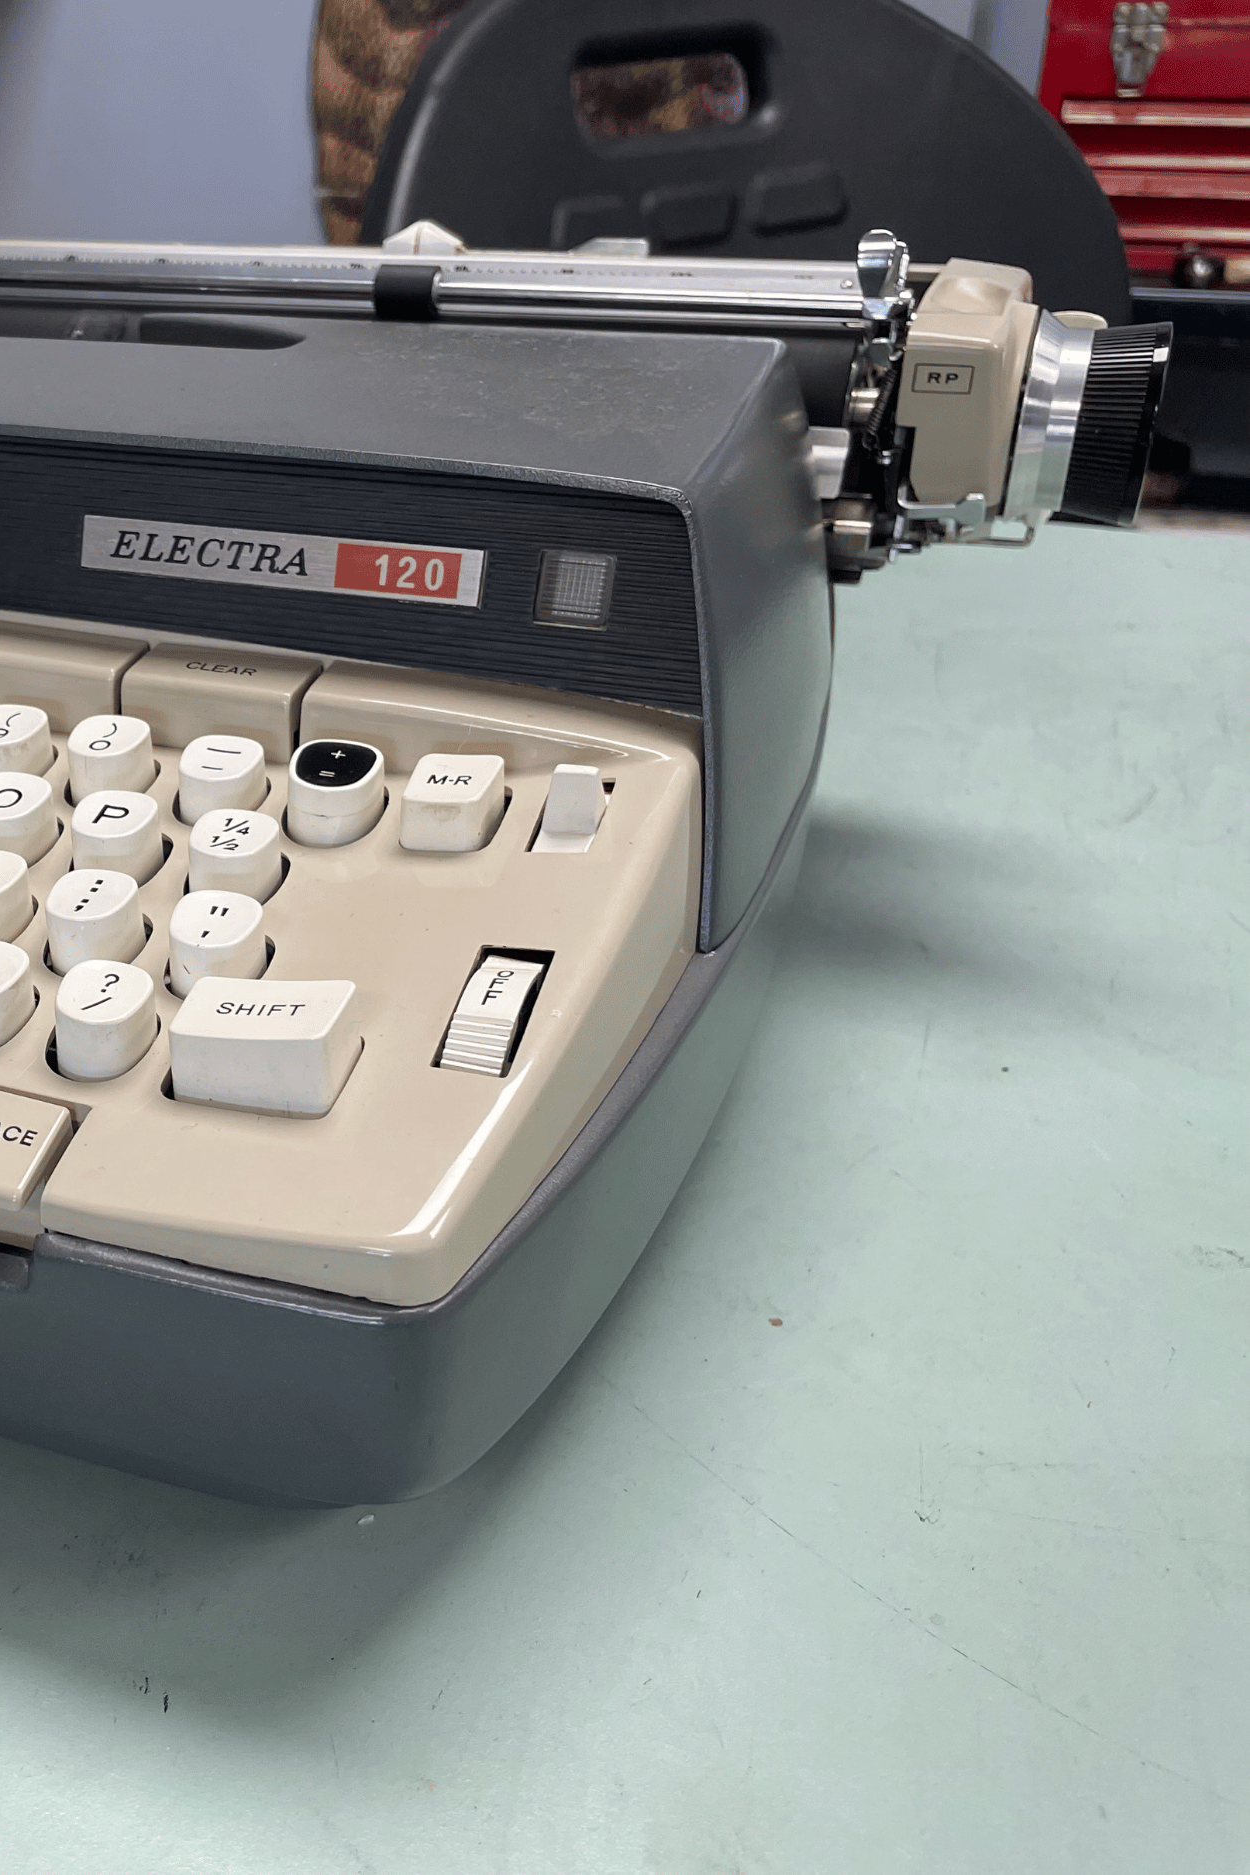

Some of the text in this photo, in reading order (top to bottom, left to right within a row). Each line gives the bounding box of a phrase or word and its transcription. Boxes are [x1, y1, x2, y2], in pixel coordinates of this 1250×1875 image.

[927, 372, 959, 384] RP
[110, 529, 309, 577] ELECTRA
[374, 552, 446, 592] 120
[185, 660, 257, 677] CLEAR
[330, 750, 346, 759] +
[318, 770, 336, 778] =
[426, 774, 472, 786] M-R
[92, 804, 130, 824] P
[89, 879, 104, 893] :
[74, 898, 90, 912] ;
[100, 973, 120, 993] ?
[480, 969, 516, 1006] OFF
[81, 996, 112, 1011] /
[216, 1002, 306, 1017] SHIFT
